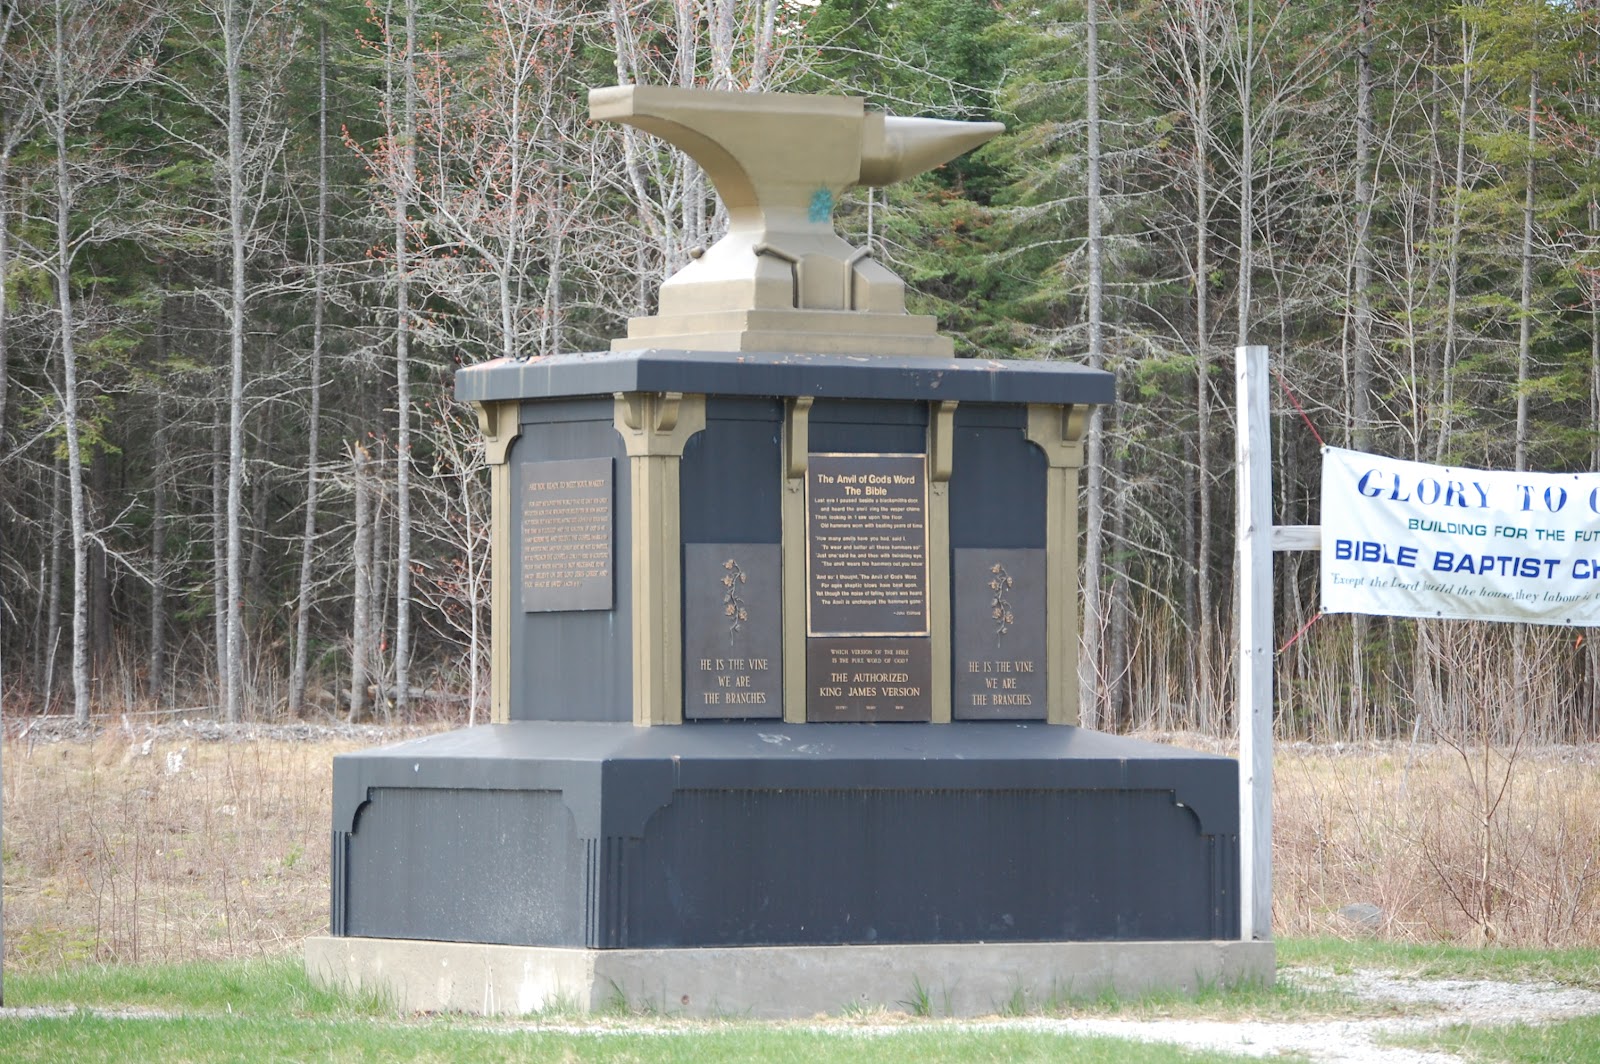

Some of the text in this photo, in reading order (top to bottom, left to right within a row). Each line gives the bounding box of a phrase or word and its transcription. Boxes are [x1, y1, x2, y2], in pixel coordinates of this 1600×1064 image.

[817, 474, 834, 484] The
[837, 474, 857, 484] Anvil
[858, 474, 867, 484] of
[893, 475, 915, 484] Word
[844, 486, 887, 496] The Bible
[1357, 469, 1491, 508] GLORY
[1516, 484, 1567, 513] TO
[1408, 518, 1487, 536] BUILDING
[1494, 525, 1528, 540] FOR
[1535, 529, 1565, 541] THE
[1335, 539, 1418, 568] BIBLE
[1433, 551, 1561, 579] BAPTIST
[1370, 576, 1388, 588] the
[1390, 577, 1420, 591] Lord
[1423, 580, 1454, 594] build
[1457, 585, 1476, 596] the
[1515, 589, 1539, 604] they
[1543, 591, 1580, 602] labour
[700, 658, 768, 671] HE IS THE VINE
[969, 661, 1034, 673] HE IS THE VINE
[718, 676, 751, 687] WE ARE
[831, 673, 909, 683] THE AUTHORIZED
[985, 678, 1017, 689] WE ARE
[704, 692, 766, 704] THE BRANCHES
[820, 687, 920, 697] KING JAMES VERSION
[972, 694, 1032, 706] THE BRANCHES
